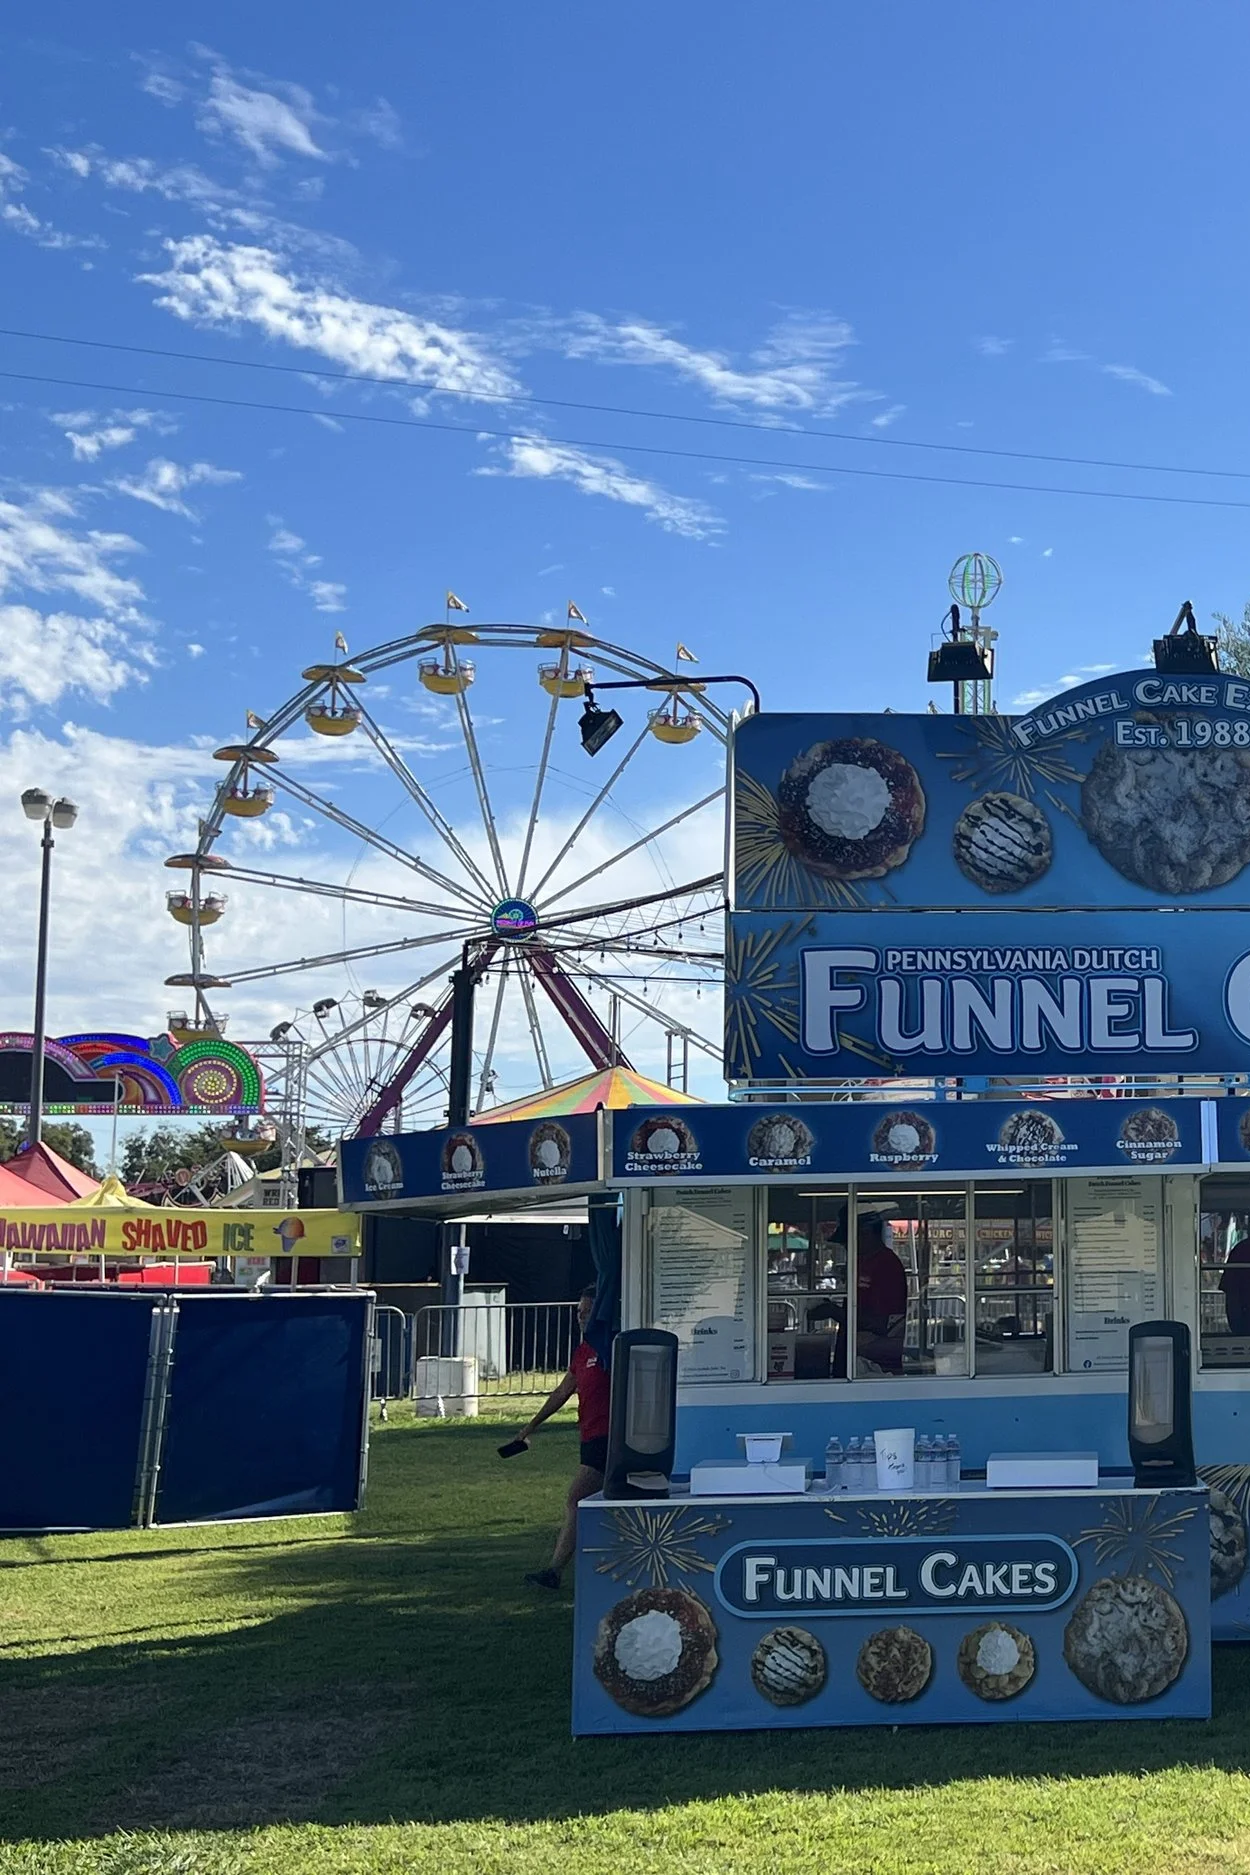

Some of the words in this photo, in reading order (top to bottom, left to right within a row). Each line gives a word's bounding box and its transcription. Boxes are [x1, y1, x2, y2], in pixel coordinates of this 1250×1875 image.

[1012, 692, 1129, 749] FUNNEL
[1134, 679, 1217, 707] CAKE
[1116, 722, 1168, 746] EST.
[1178, 720, 1250, 747] 1988
[886, 950, 1068, 973] PENNSYLVANIA
[1074, 949, 1158, 971] DUTCH
[803, 949, 1196, 1052] FUNNEL
[986, 1143, 1037, 1155] Whipped
[1040, 1142, 1078, 1152] Cream
[1116, 1139, 1182, 1150] Cinnamon
[627, 1151, 701, 1162] Strawberry
[749, 1156, 812, 1167] Caramel
[870, 1152, 939, 1164] Raspberry
[998, 1155, 1007, 1163] &
[1010, 1153, 1067, 1163] Chocolate
[1131, 1151, 1168, 1162] Sugar
[625, 1162, 703, 1171] Cheesecake
[442, 1170, 484, 1181] Strawberry
[533, 1167, 567, 1178] Nutella
[365, 1182, 377, 1192] Ice
[380, 1181, 404, 1191] Cream
[122, 1218, 207, 1252] SHAVED
[223, 1223, 254, 1251] ICE
[744, 1557, 906, 1600] FUNNEL
[921, 1553, 1056, 1597] CAKES
